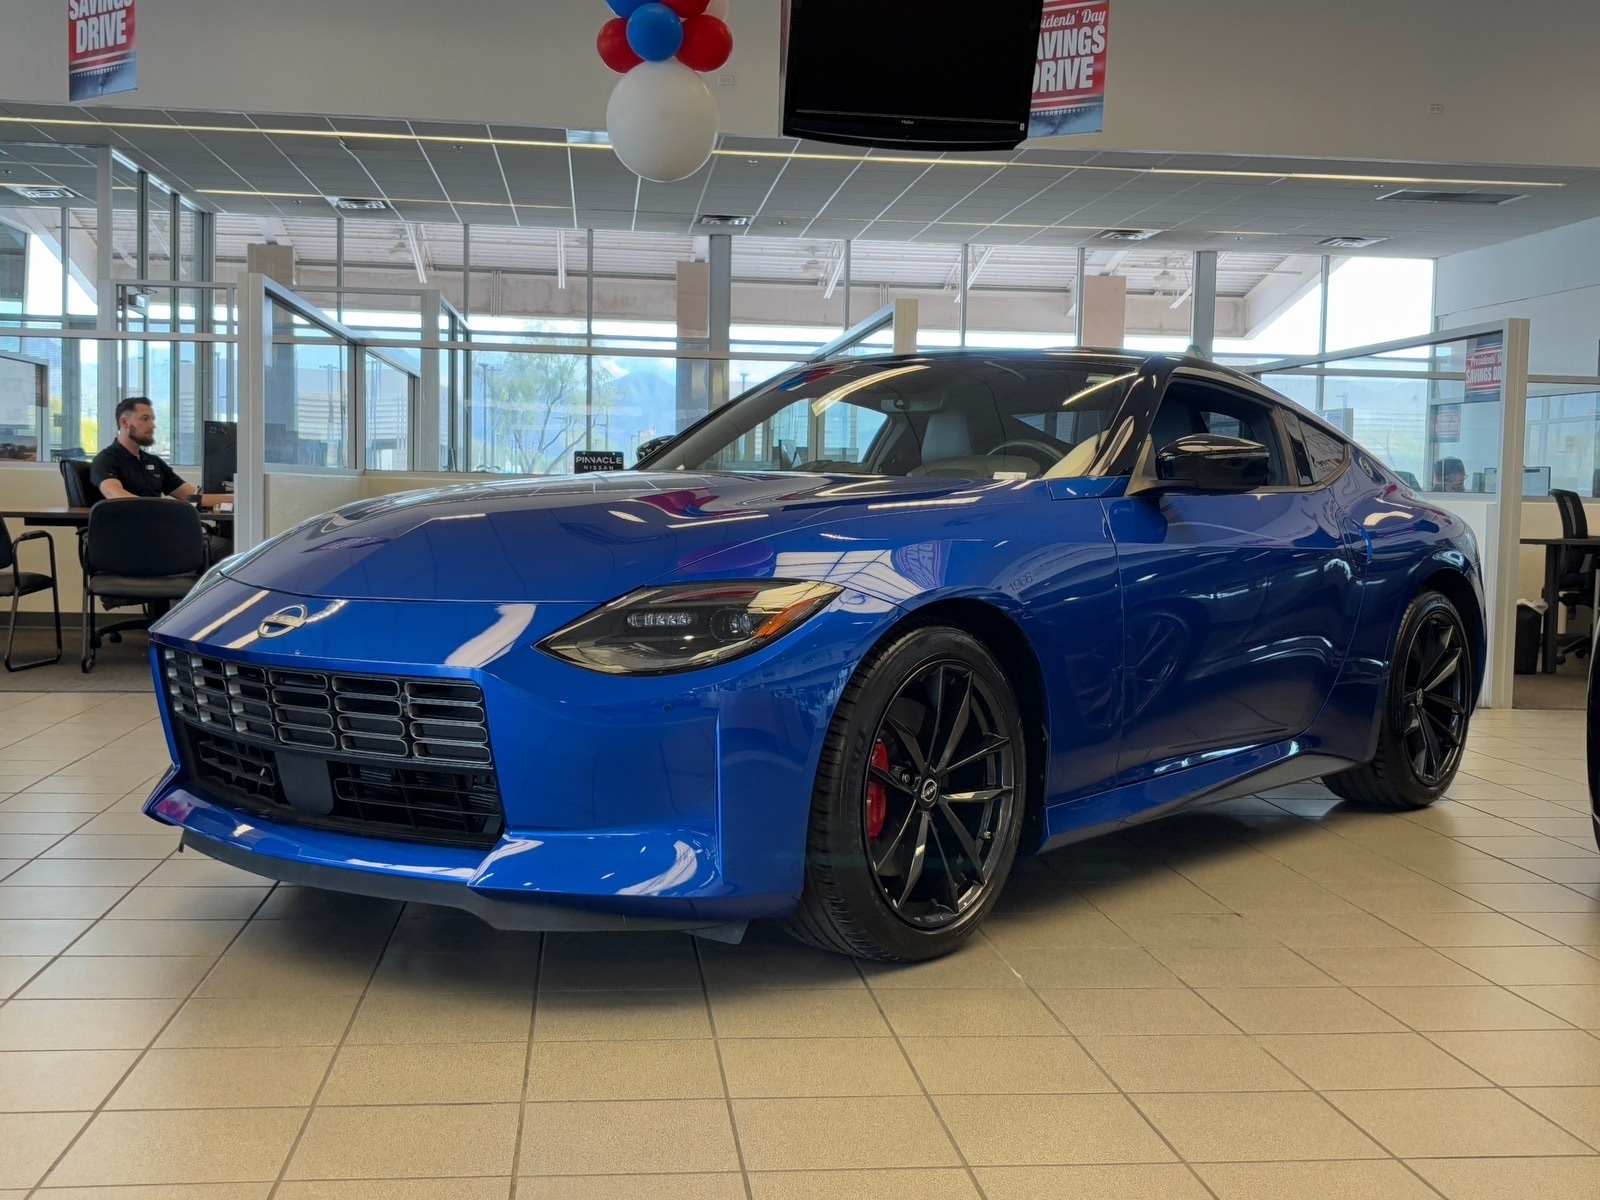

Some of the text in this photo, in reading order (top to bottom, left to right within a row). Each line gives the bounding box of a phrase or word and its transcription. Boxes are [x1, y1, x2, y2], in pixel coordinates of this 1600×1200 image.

[69, 0, 133, 20] SAVI
[1041, 9, 1106, 28] idents' Day
[76, 10, 127, 53] DRIVE
[1037, 25, 1106, 60] AVINGS
[1466, 367, 1492, 384] SAVINGS
[576, 456, 623, 464] PINNACLE
